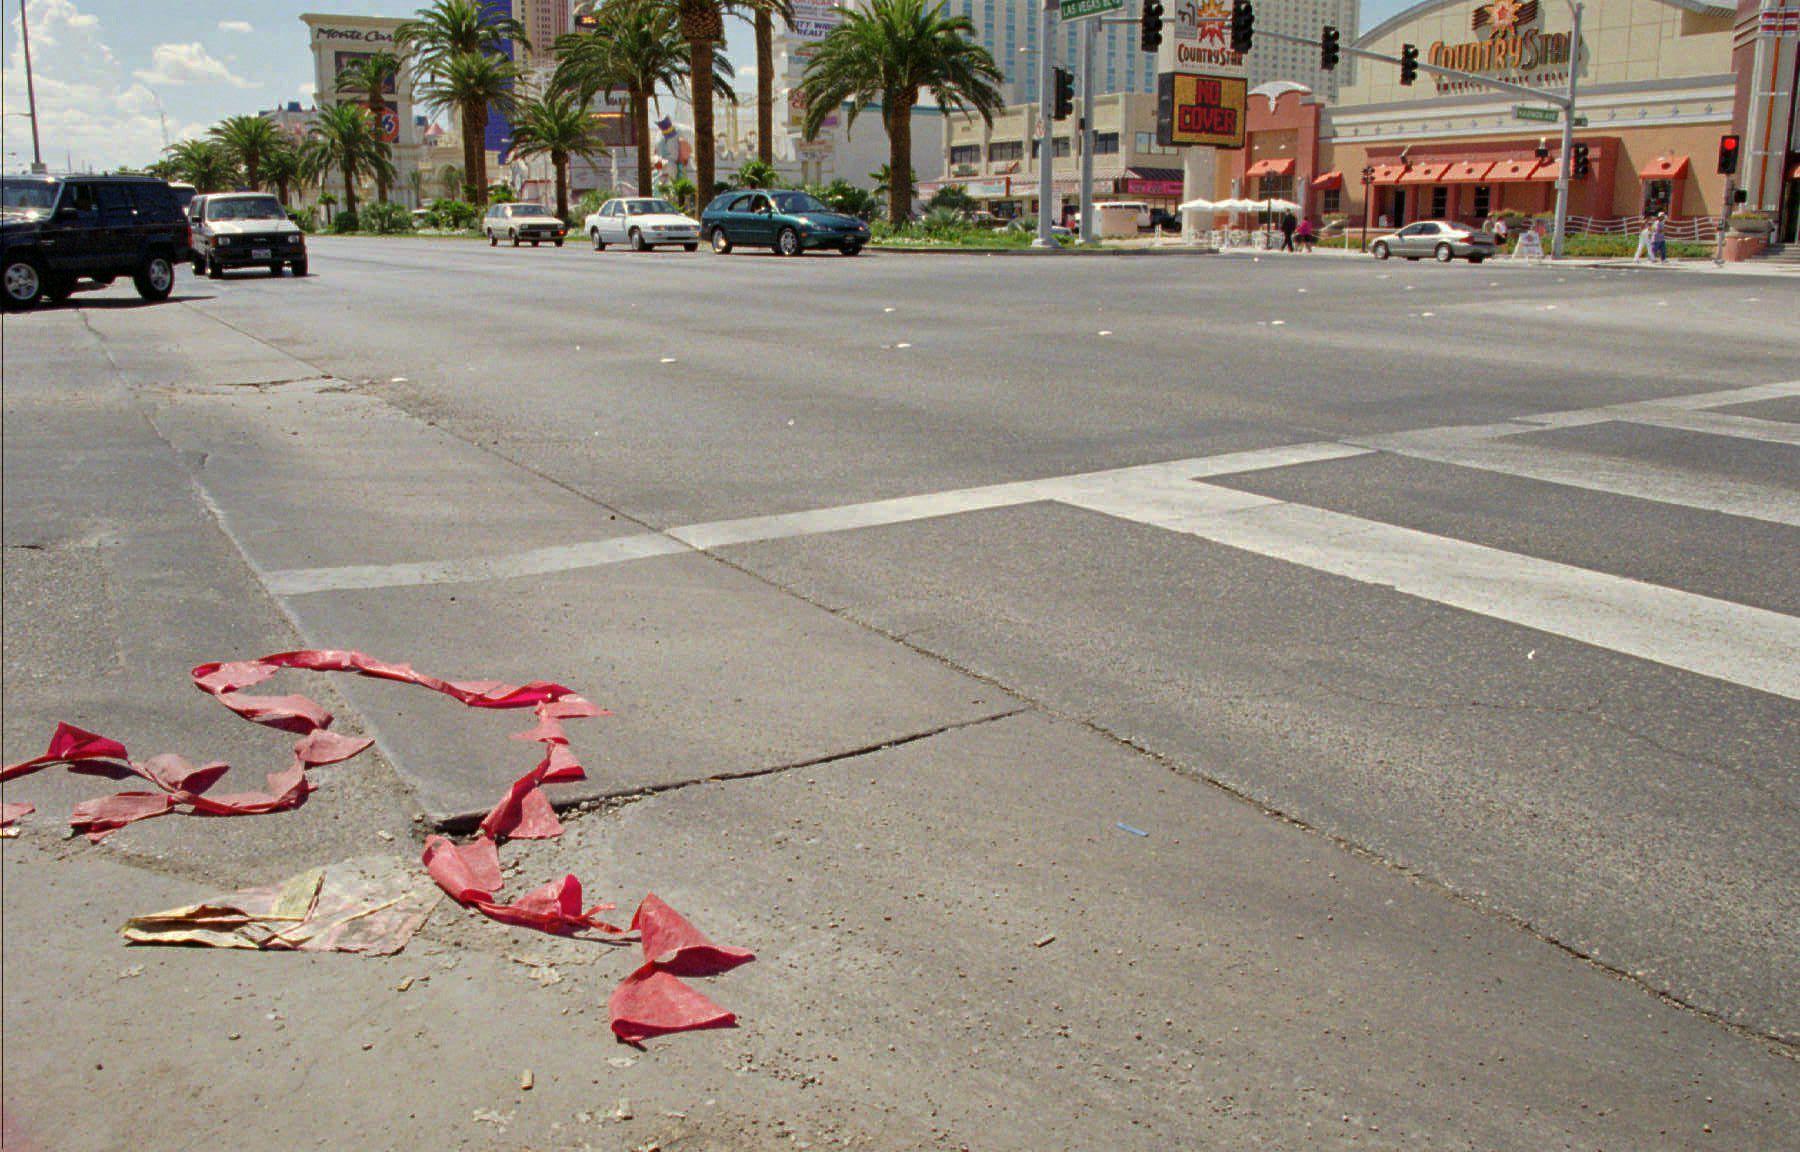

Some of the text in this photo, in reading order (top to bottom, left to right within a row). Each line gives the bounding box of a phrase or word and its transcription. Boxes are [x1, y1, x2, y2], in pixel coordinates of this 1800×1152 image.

[1063, 3, 1077, 16] LAS
[317, 27, 361, 39] Monte
[1197, 80, 1220, 105] NO
[1180, 106, 1235, 133] COVER
